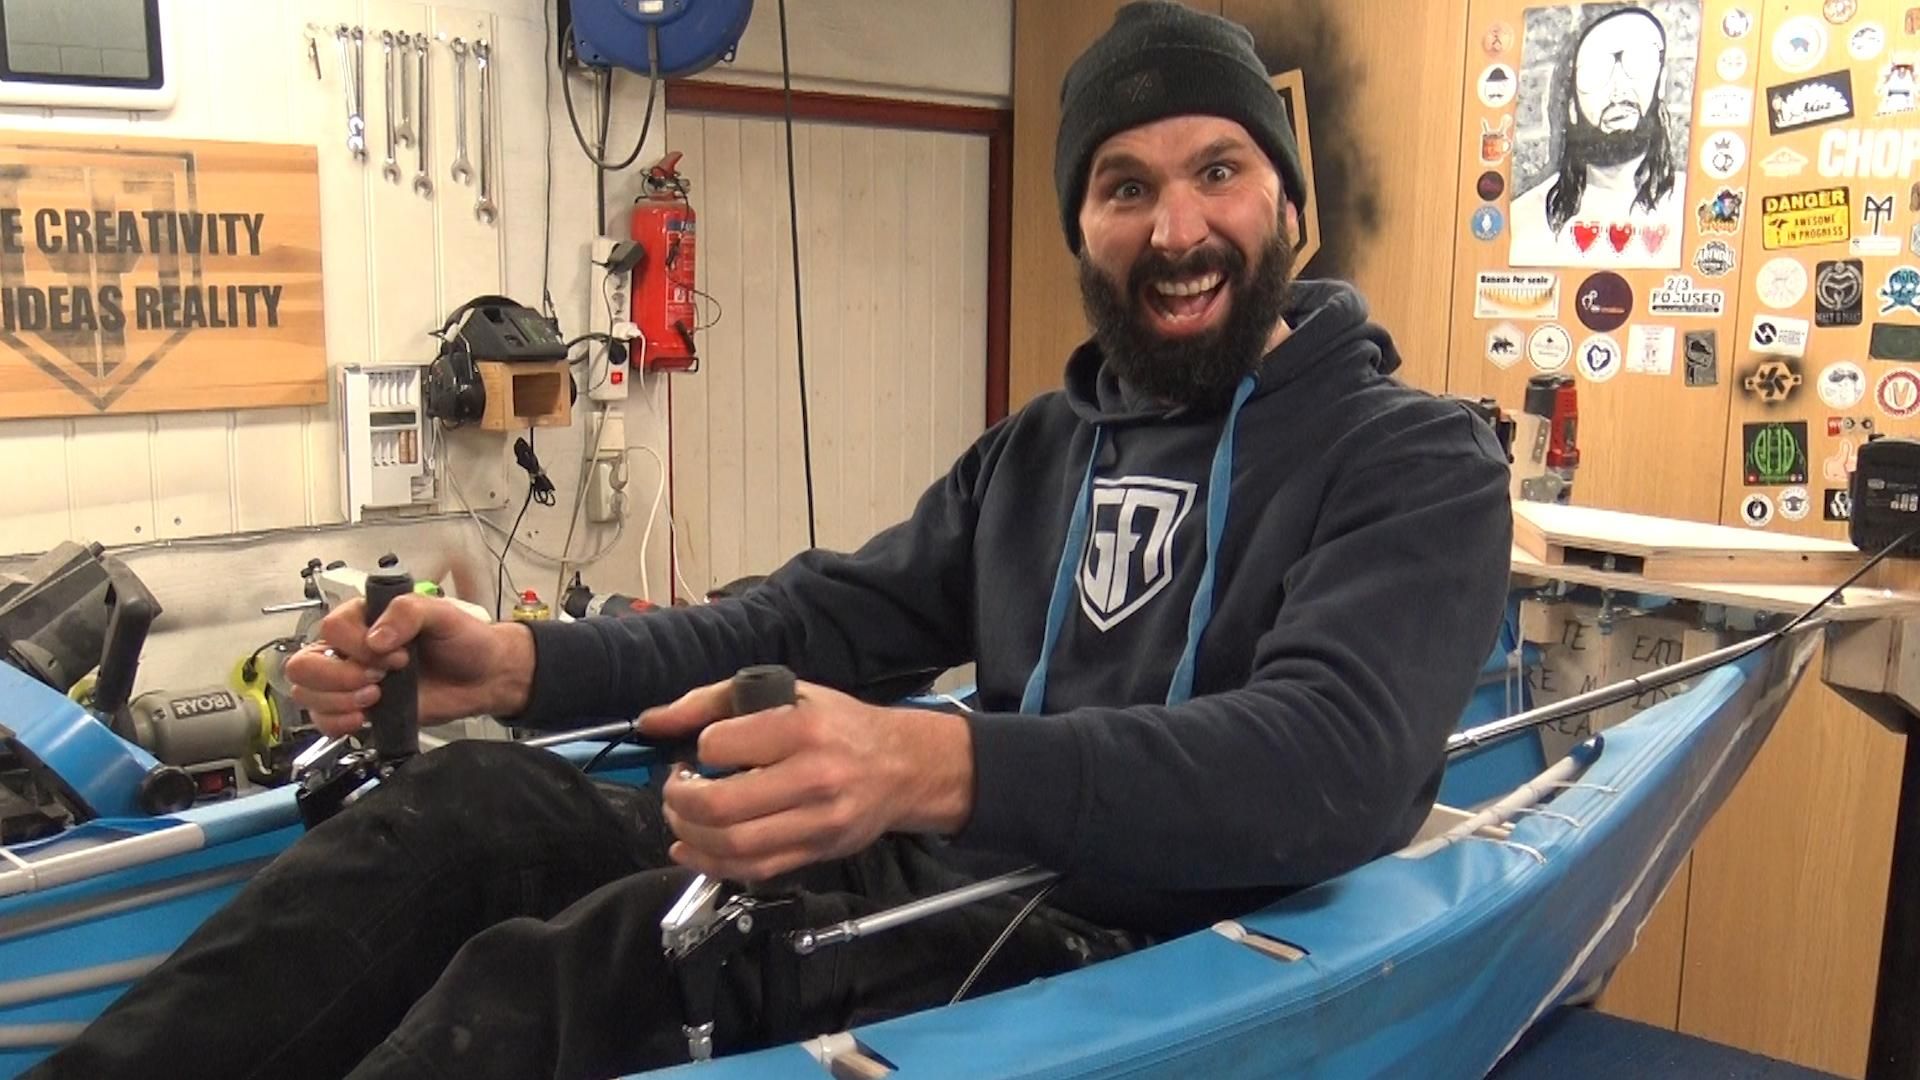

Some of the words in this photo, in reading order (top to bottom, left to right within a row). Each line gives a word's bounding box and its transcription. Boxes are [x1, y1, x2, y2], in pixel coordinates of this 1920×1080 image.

[1766, 190, 1845, 213] DANGER
[34, 207, 264, 256] CREATIVITY
[1794, 214, 1835, 226] AWESOME
[1787, 231, 1796, 240] IN
[1799, 226, 1844, 240] PROGRESS
[1480, 275, 1510, 283] Banana
[1513, 275, 1525, 283] for
[1528, 276, 1548, 284] scale
[1, 285, 126, 330] IDEAS
[136, 285, 283, 329] REALITY
[173, 692, 232, 715] RYOBI
